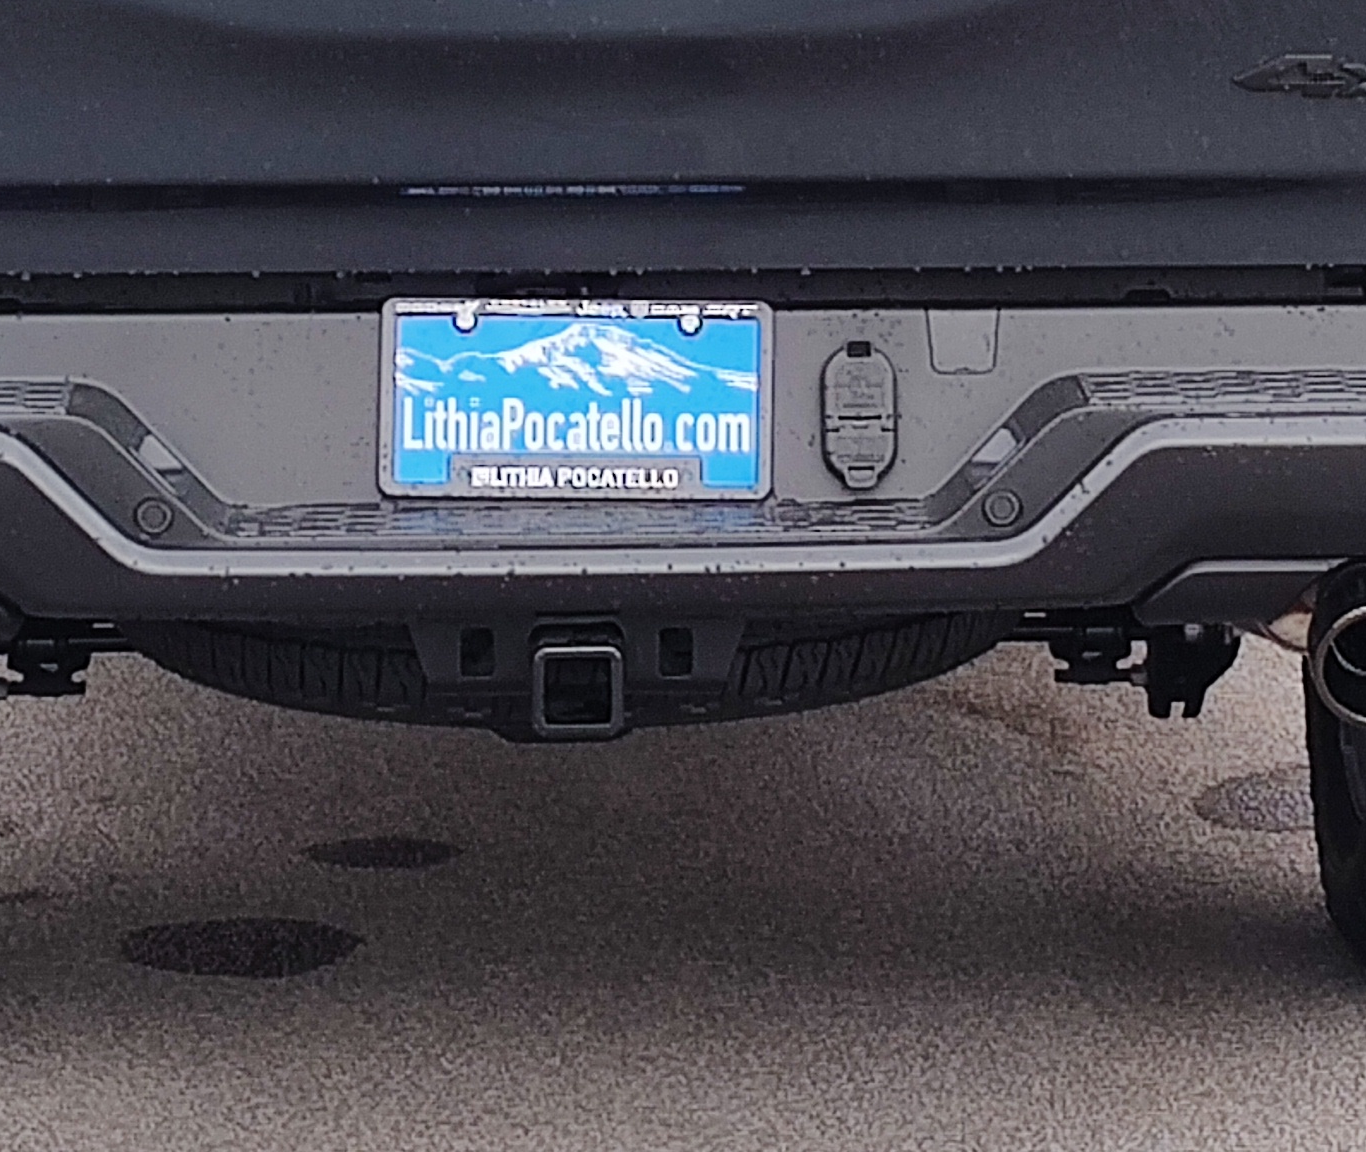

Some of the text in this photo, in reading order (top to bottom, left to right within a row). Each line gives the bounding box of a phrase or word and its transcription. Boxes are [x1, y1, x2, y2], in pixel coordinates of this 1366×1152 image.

[402, 397, 751, 452] LithiaPocatello.com
[489, 465, 680, 489] LITHIA POCATELLO
